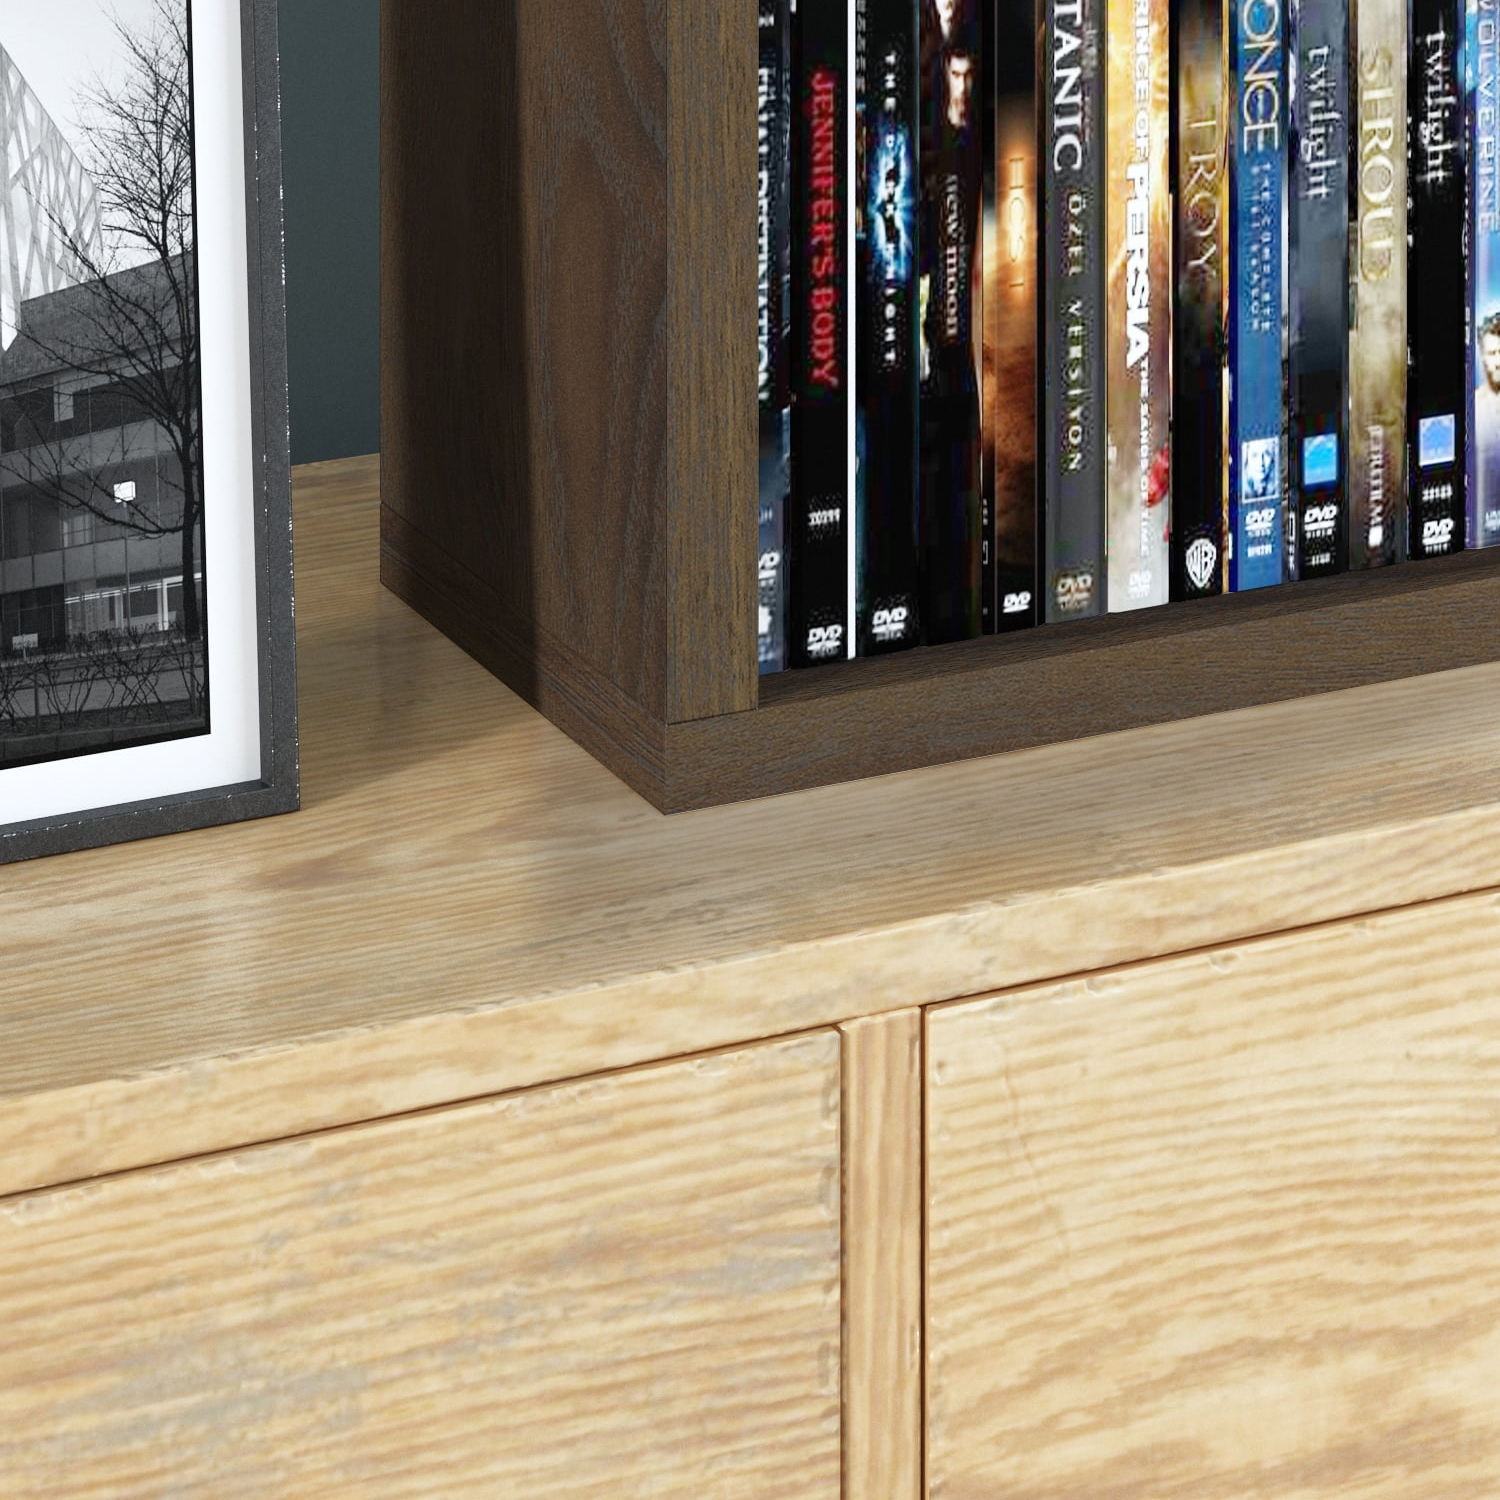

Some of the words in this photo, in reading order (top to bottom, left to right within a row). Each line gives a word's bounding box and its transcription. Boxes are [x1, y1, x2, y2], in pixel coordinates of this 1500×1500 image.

[1300, 44, 1342, 200] twilight
[1420, 31, 1458, 185] twilight
[1134, 109, 1150, 160] OF
[811, 72, 838, 278] JENNIFER'S
[1184, 104, 1218, 280] TROY
[1125, 161, 1150, 370] PERSIA
[811, 288, 839, 388] BODY
[1244, 508, 1276, 524] DVD
[1303, 505, 1337, 523] DVD
[1422, 517, 1454, 537] DVD
[1003, 591, 1031, 608] DVD
[1056, 573, 1092, 593] DVD
[873, 606, 907, 625] DVD
[807, 624, 842, 643] DVD
